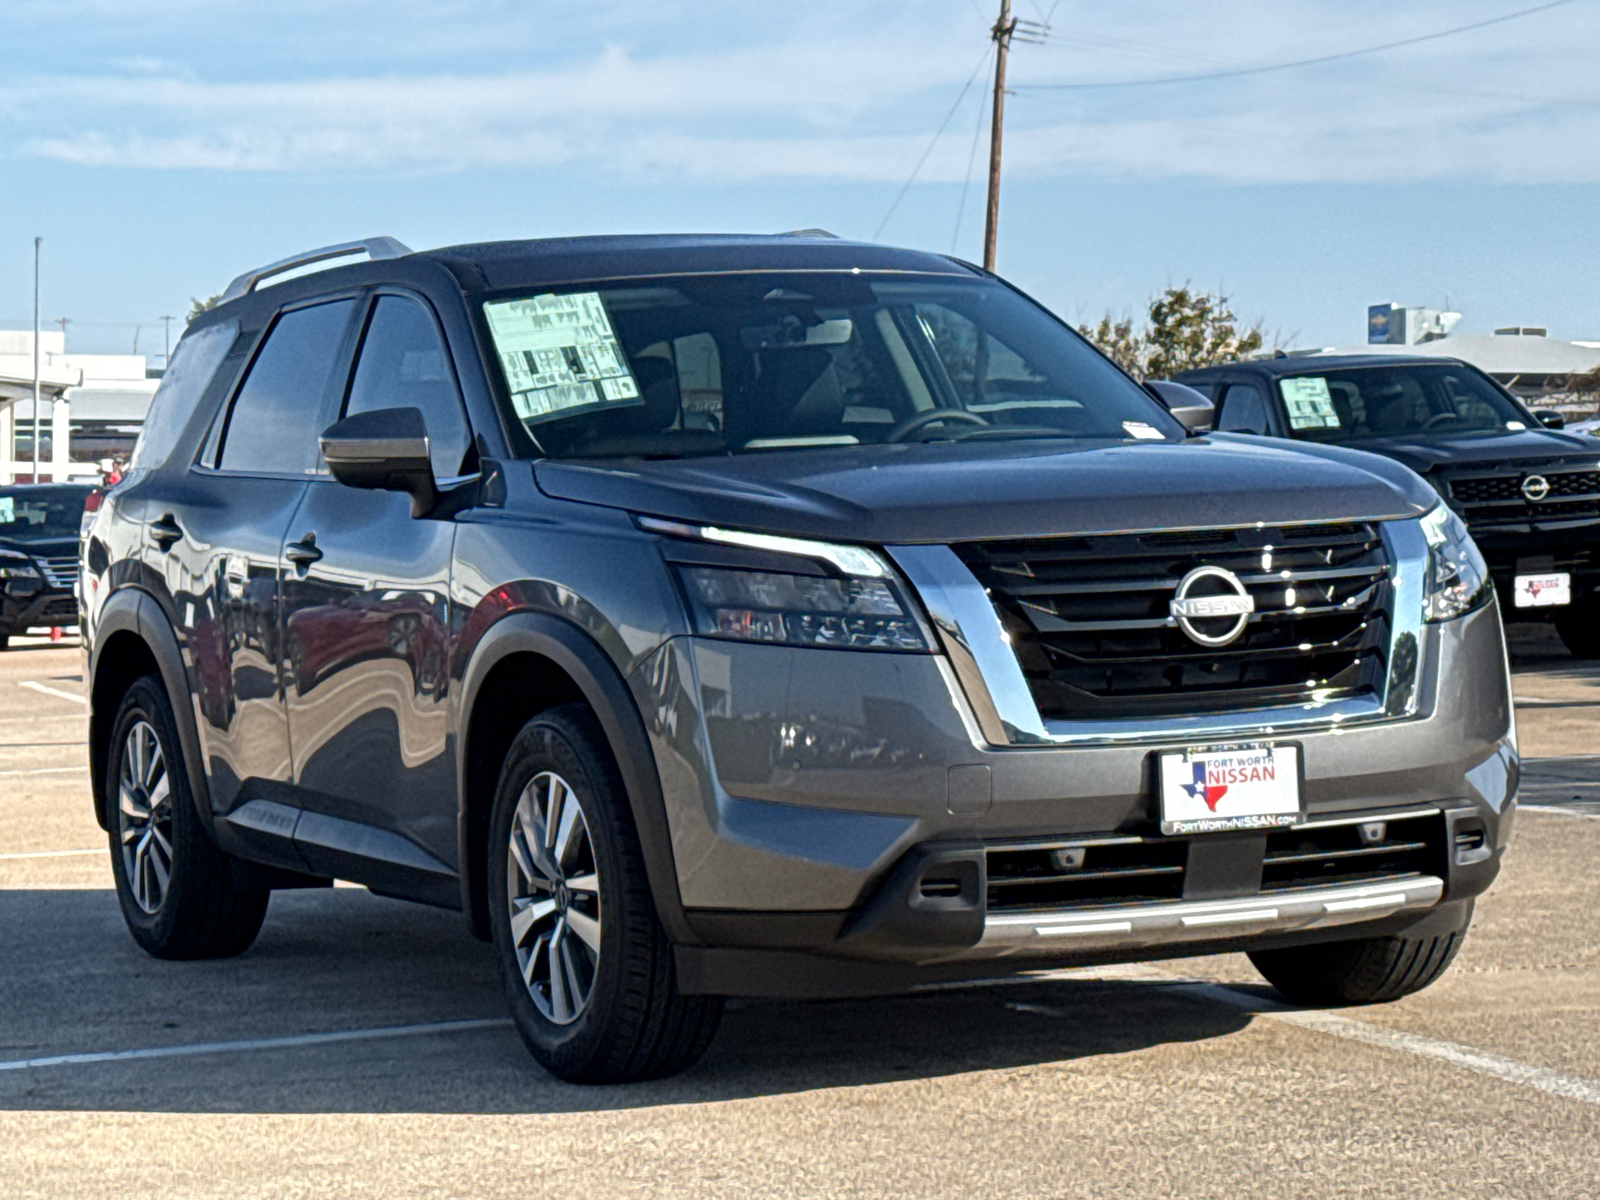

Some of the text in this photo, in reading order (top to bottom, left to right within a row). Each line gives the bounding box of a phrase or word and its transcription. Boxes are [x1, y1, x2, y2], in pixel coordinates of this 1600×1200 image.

[1172, 599, 1251, 615] NISSAN
[1207, 755, 1275, 769] FORT WORTH
[1208, 766, 1275, 784] NISSAN
